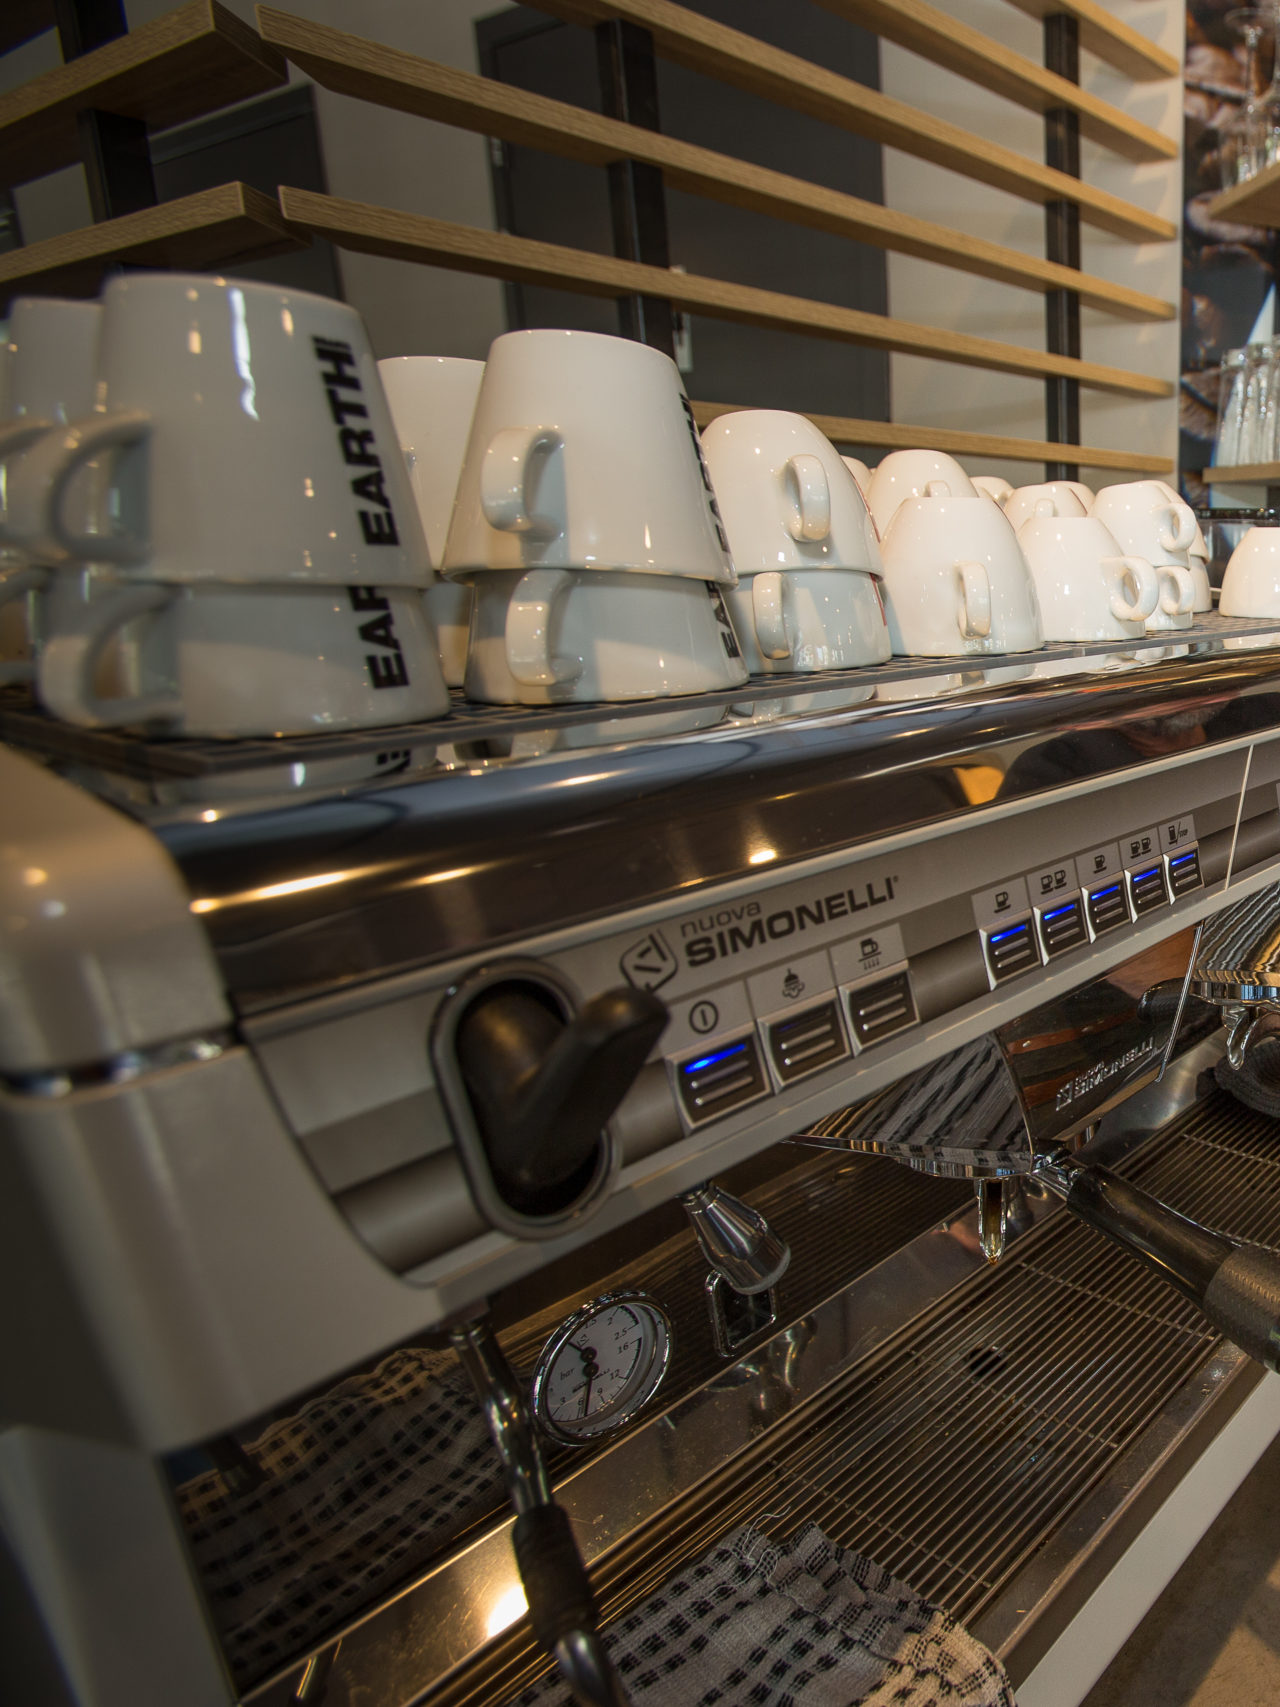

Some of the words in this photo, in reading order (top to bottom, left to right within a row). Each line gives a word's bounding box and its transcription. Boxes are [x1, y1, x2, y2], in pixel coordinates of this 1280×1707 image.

[680, 901, 762, 937] nuova
[685, 876, 895, 968] SIMONELLI
[614, 1328, 628, 1340] 2.5
[618, 1341, 629, 1354] 16
